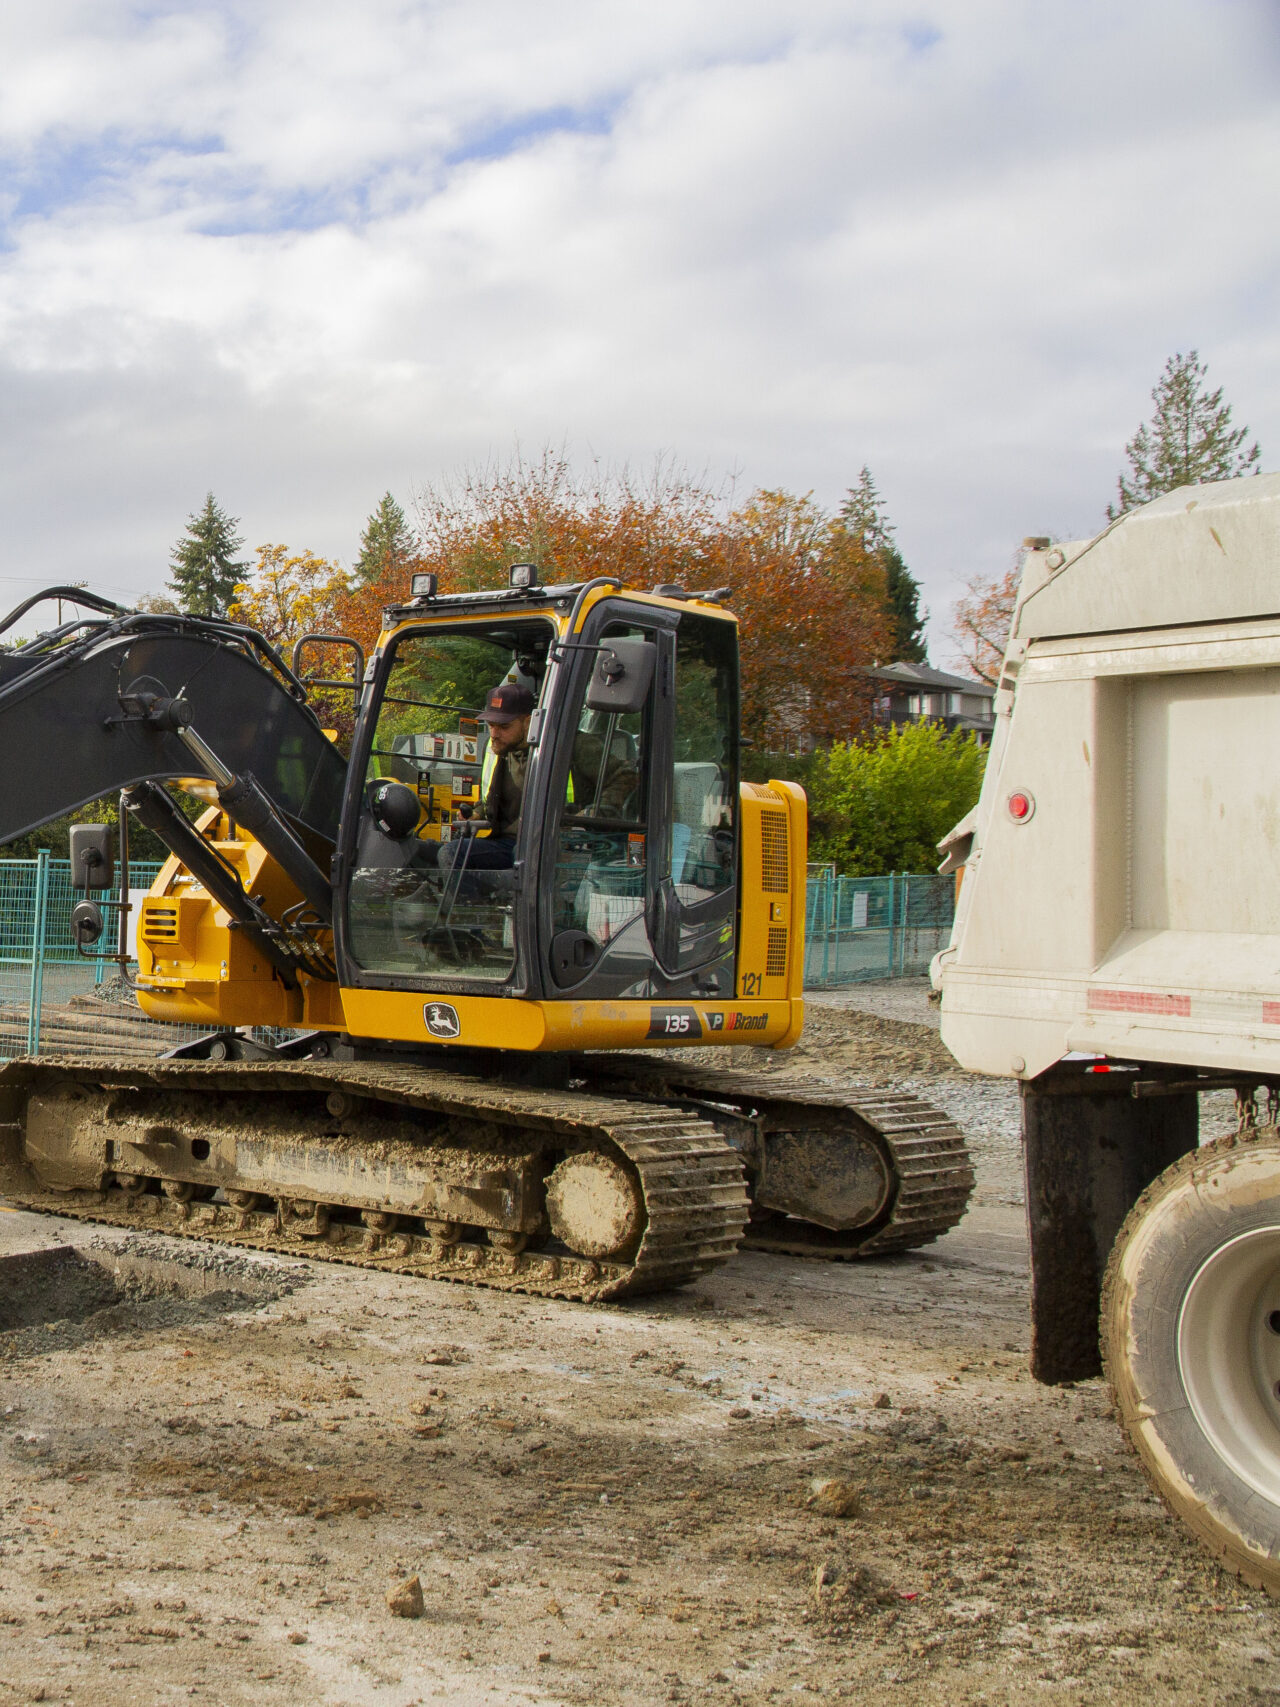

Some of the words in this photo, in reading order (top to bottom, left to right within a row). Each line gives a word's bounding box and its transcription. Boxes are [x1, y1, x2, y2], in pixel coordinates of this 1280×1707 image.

[742, 973, 762, 995] 121
[665, 1015, 690, 1032] 135
[713, 1014, 723, 1029] P
[734, 1012, 768, 1030] Brandt
